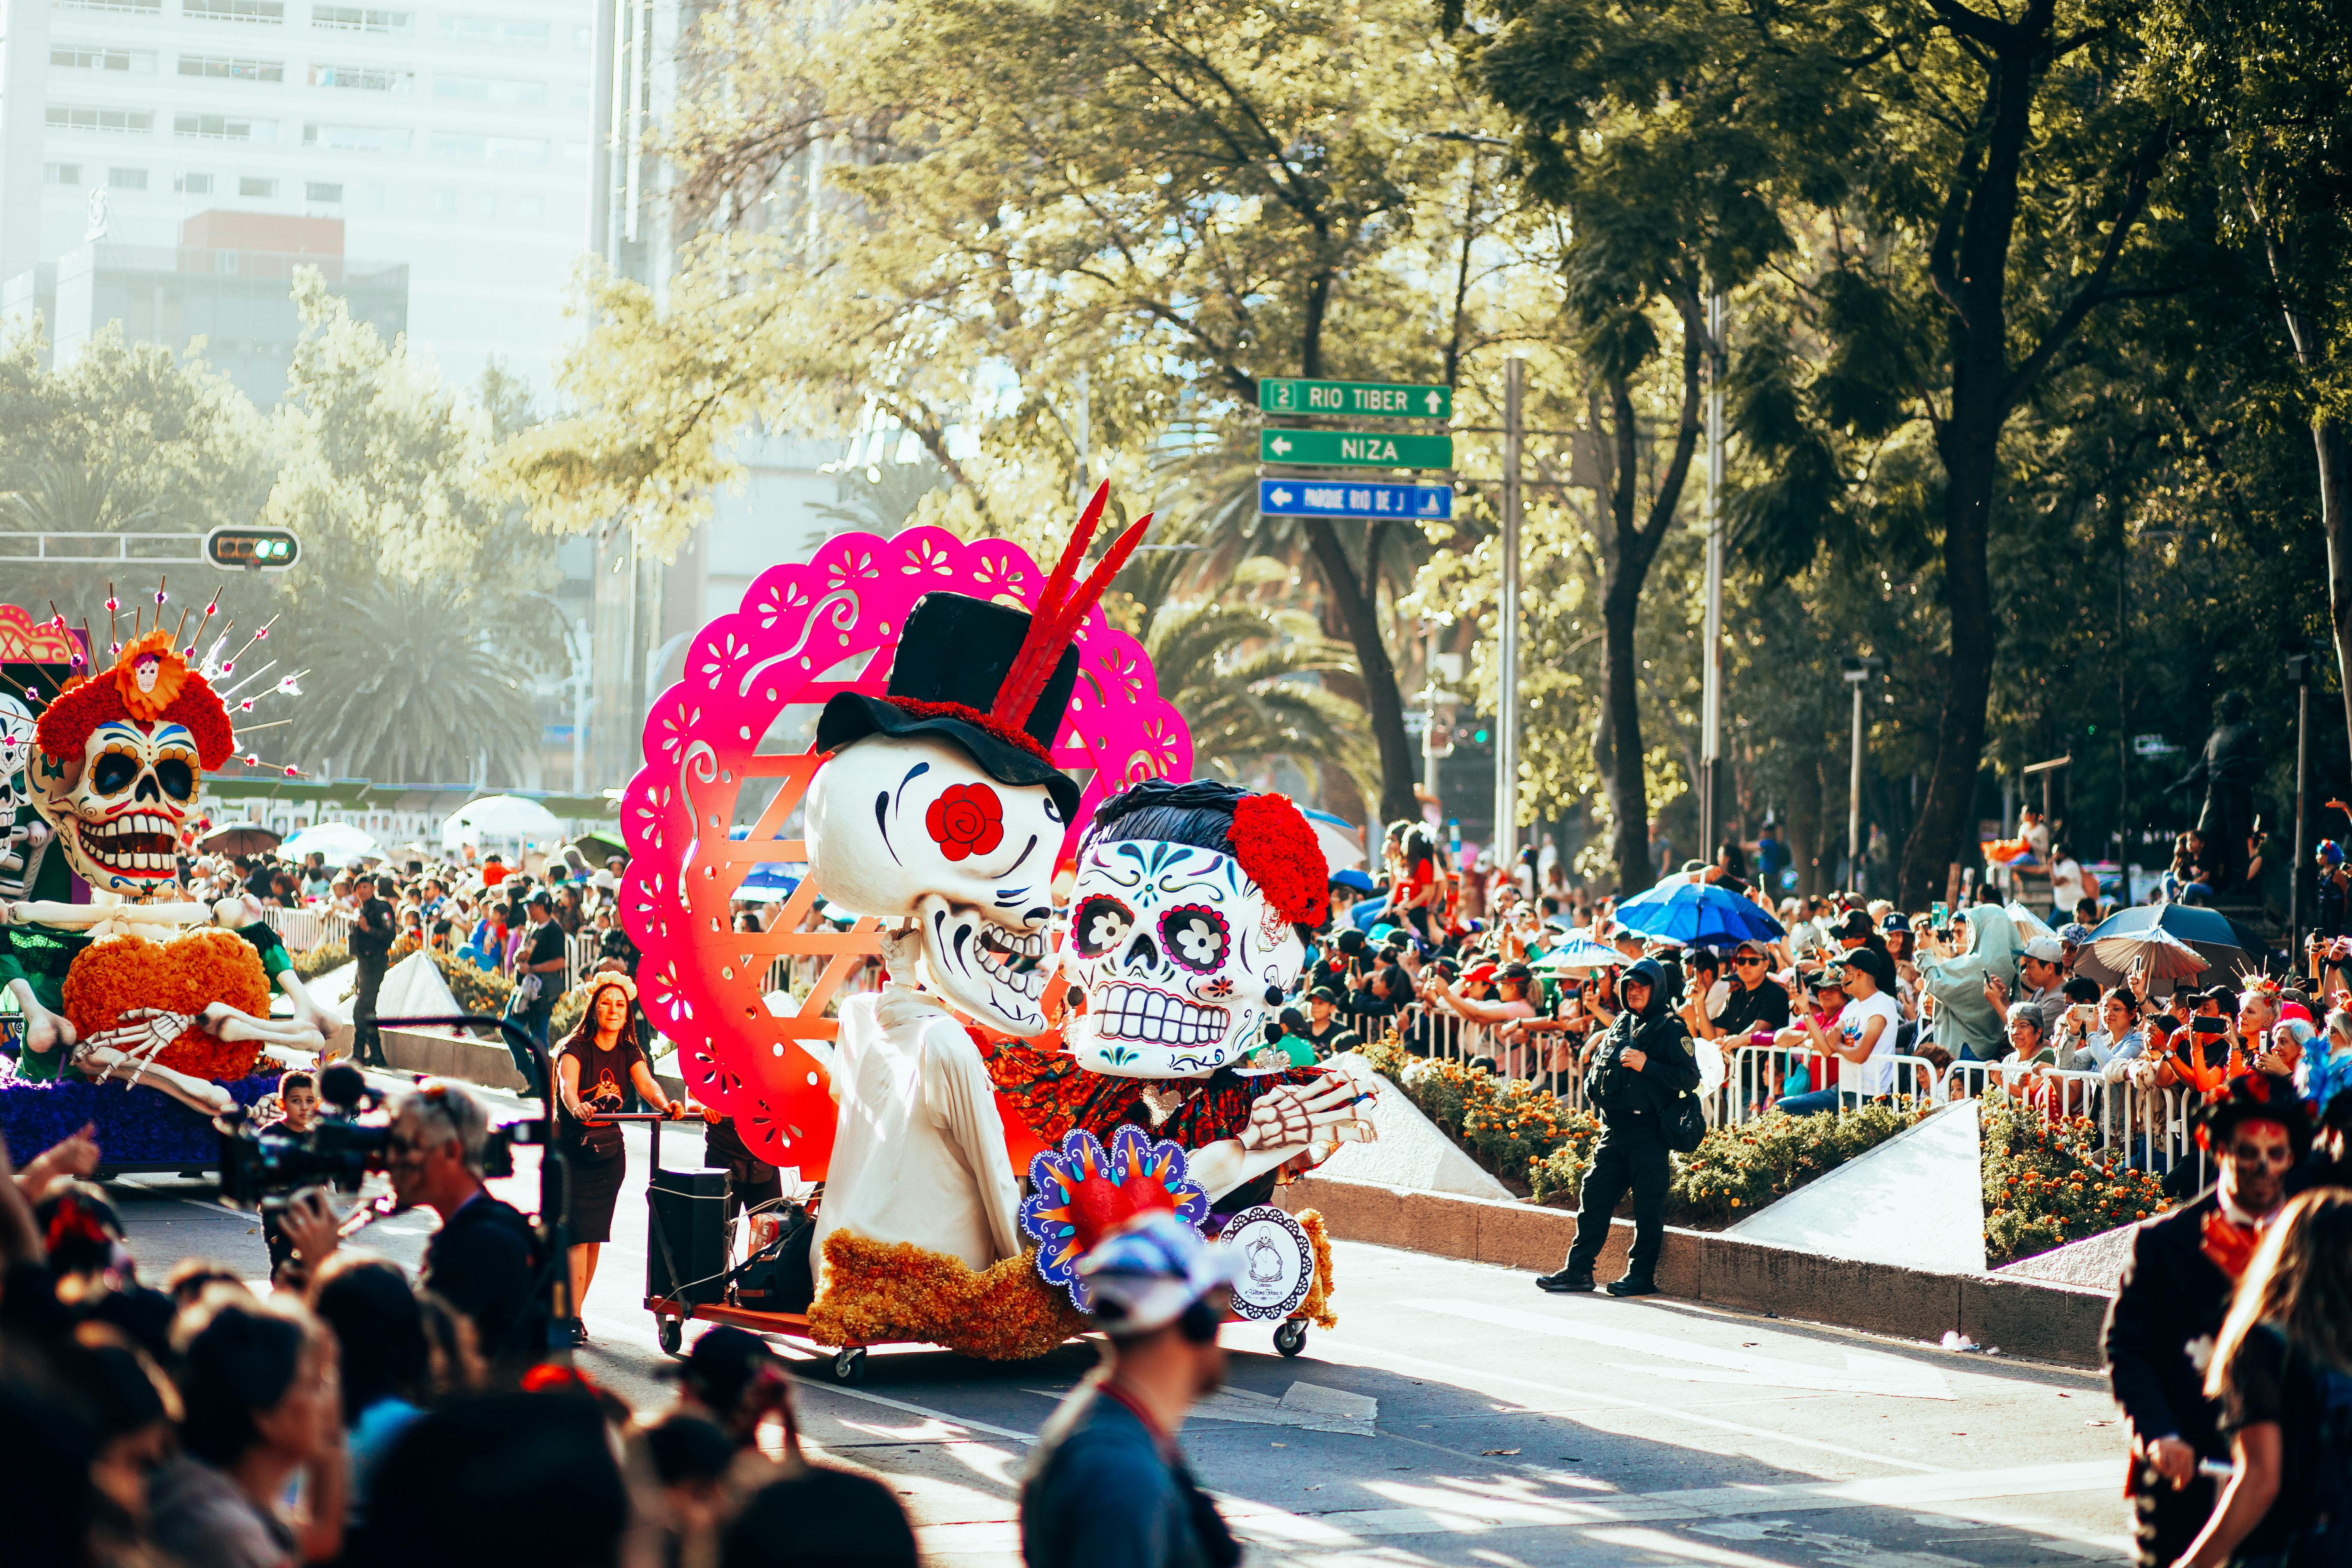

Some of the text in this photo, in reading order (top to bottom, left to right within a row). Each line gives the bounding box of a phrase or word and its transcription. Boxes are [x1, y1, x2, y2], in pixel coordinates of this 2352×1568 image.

[1279, 387, 1407, 410] 2 RIO TIBER
[1342, 438, 1398, 460] NIZA
[1350, 490, 1371, 510] RIO
[1376, 490, 1390, 511] DE
[1396, 492, 1404, 511] J
[1889, 916, 1896, 925] M
